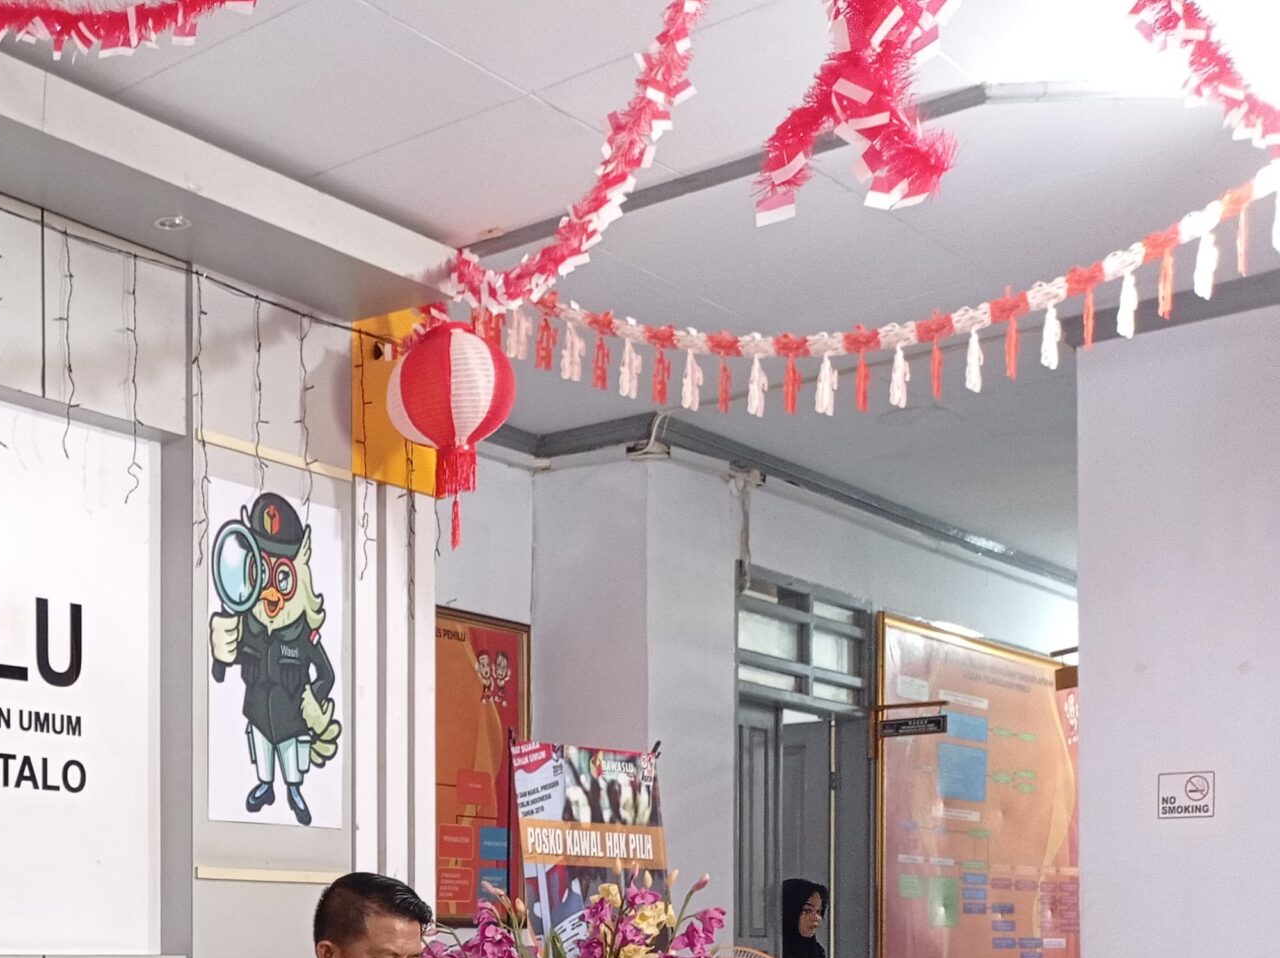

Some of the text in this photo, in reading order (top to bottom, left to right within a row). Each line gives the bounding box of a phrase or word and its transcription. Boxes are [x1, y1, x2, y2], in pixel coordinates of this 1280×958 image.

[19, 709, 82, 737] UMUM
[1161, 796, 1176, 805] NO
[1161, 804, 1210, 815] SMOKING
[527, 827, 654, 860] POSKO KAWAL HAK PILIH
